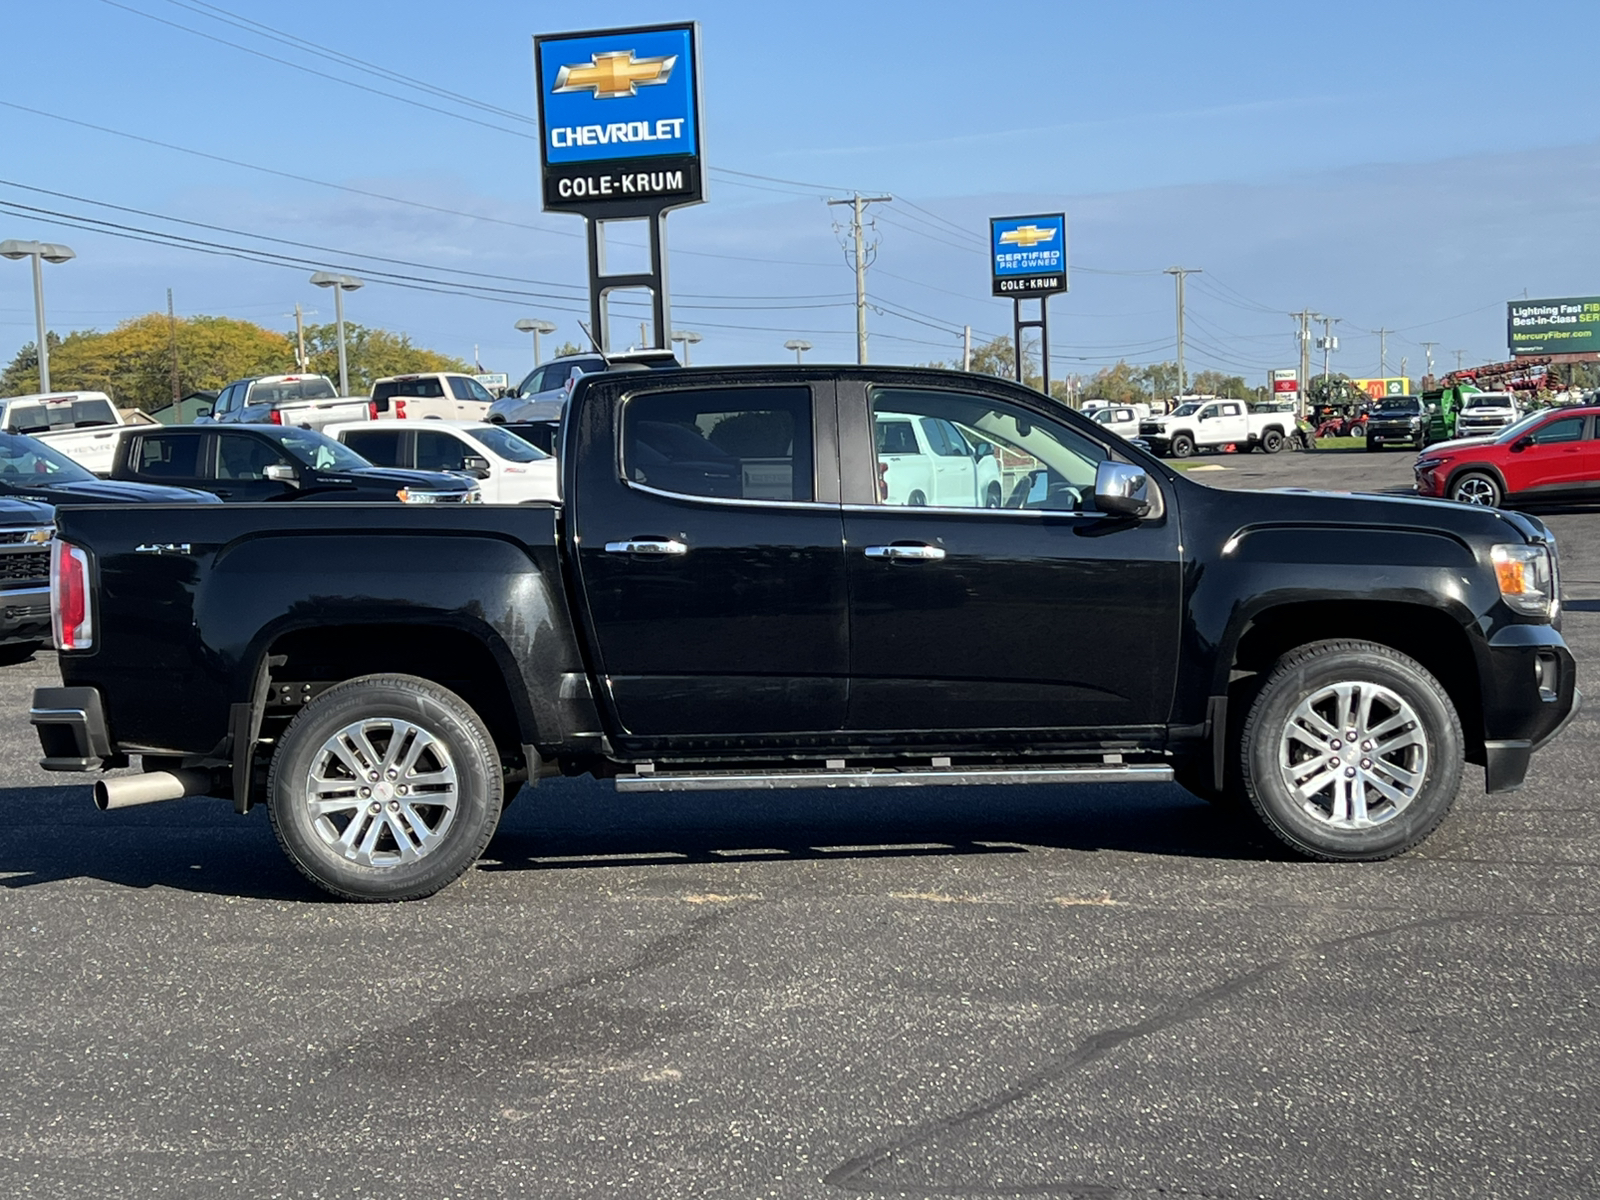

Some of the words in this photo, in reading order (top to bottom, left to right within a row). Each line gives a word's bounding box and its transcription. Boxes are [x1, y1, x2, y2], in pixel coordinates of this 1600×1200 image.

[551, 118, 685, 148] CHEVROLET
[558, 171, 683, 198] COLE-KRUM
[997, 251, 1060, 262] CERTIFIED
[1001, 278, 1058, 290] COLE-KRUM
[1513, 306, 1558, 317] Lightning
[1560, 304, 1582, 314] Fast
[1513, 315, 1577, 326] Best-in-Class
[1513, 331, 1592, 340] MercuryFiber.com
